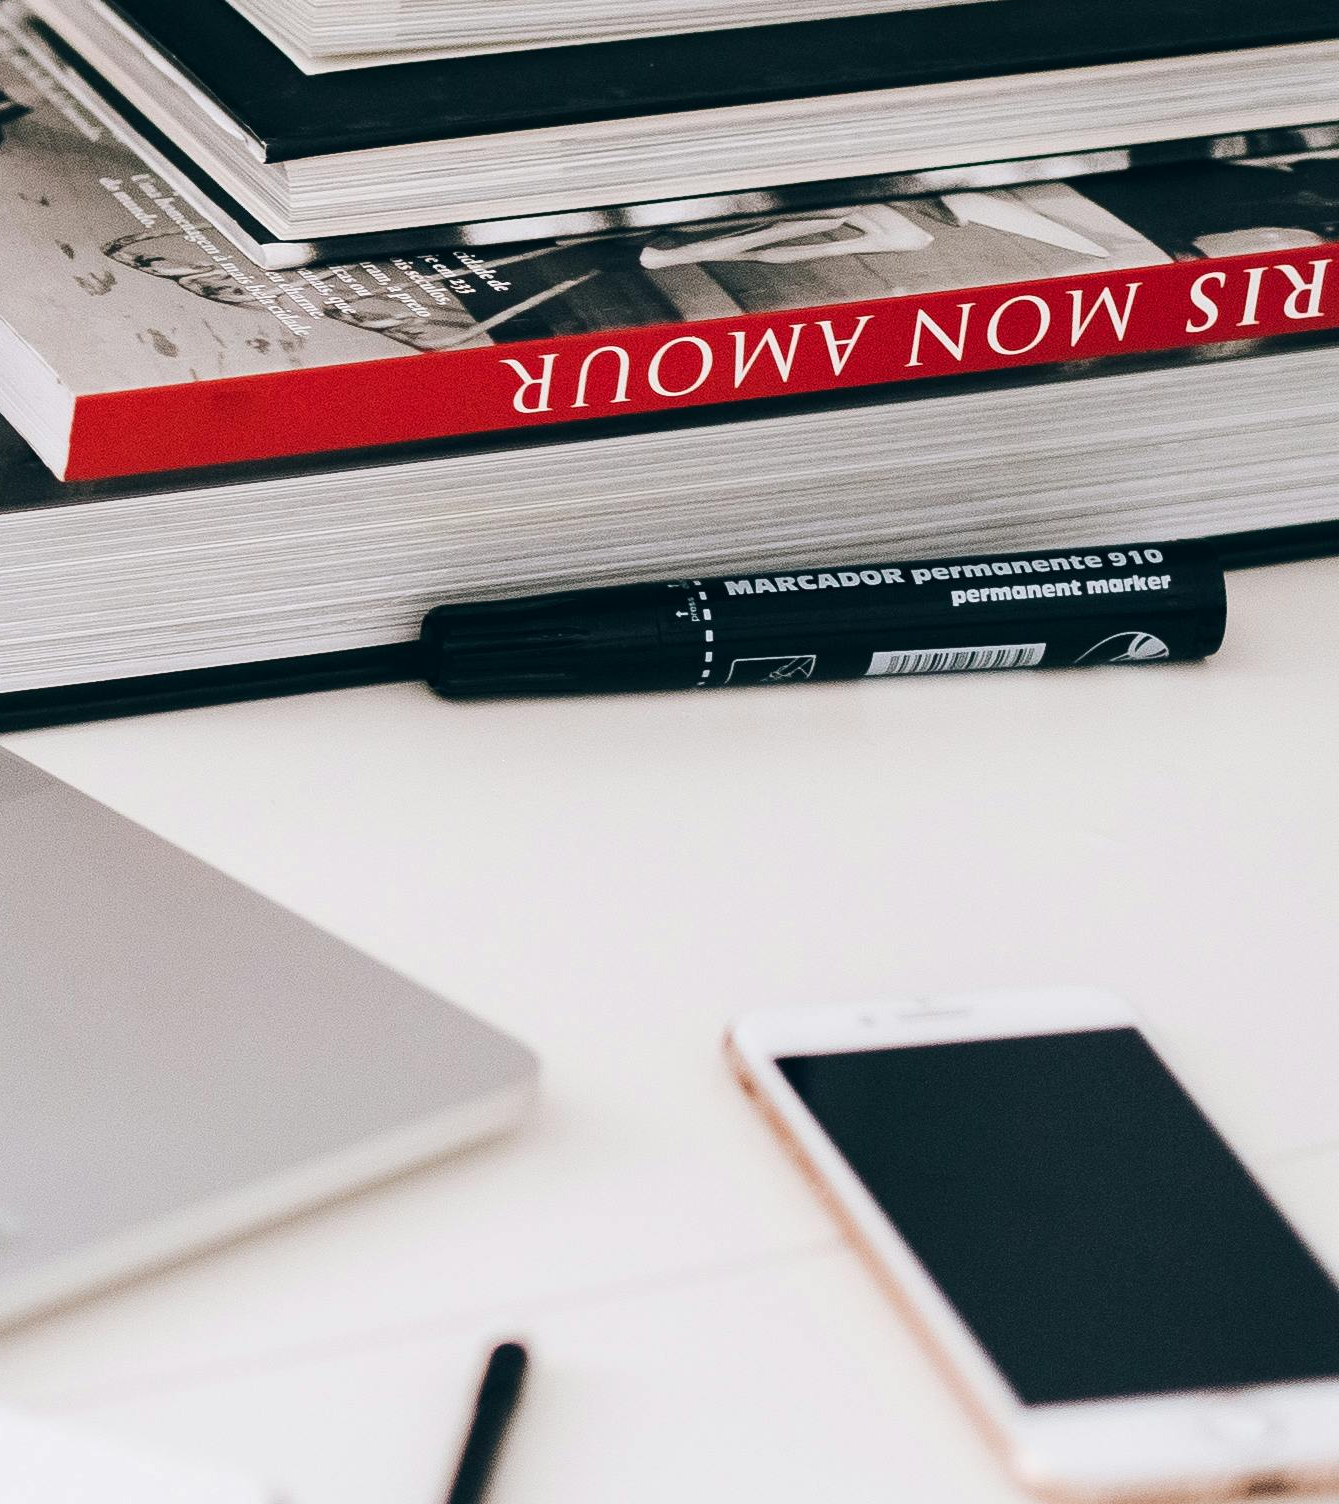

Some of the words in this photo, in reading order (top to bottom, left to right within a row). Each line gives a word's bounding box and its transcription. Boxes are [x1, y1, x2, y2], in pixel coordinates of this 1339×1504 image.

[906, 282, 1143, 368] MON
[499, 315, 878, 414] AMOUR
[724, 566, 904, 597] MARCADOR
[911, 552, 1104, 586] permanente
[1107, 548, 1164, 570] 910
[951, 577, 1082, 608] permanent
[1085, 571, 1173, 594] marker
